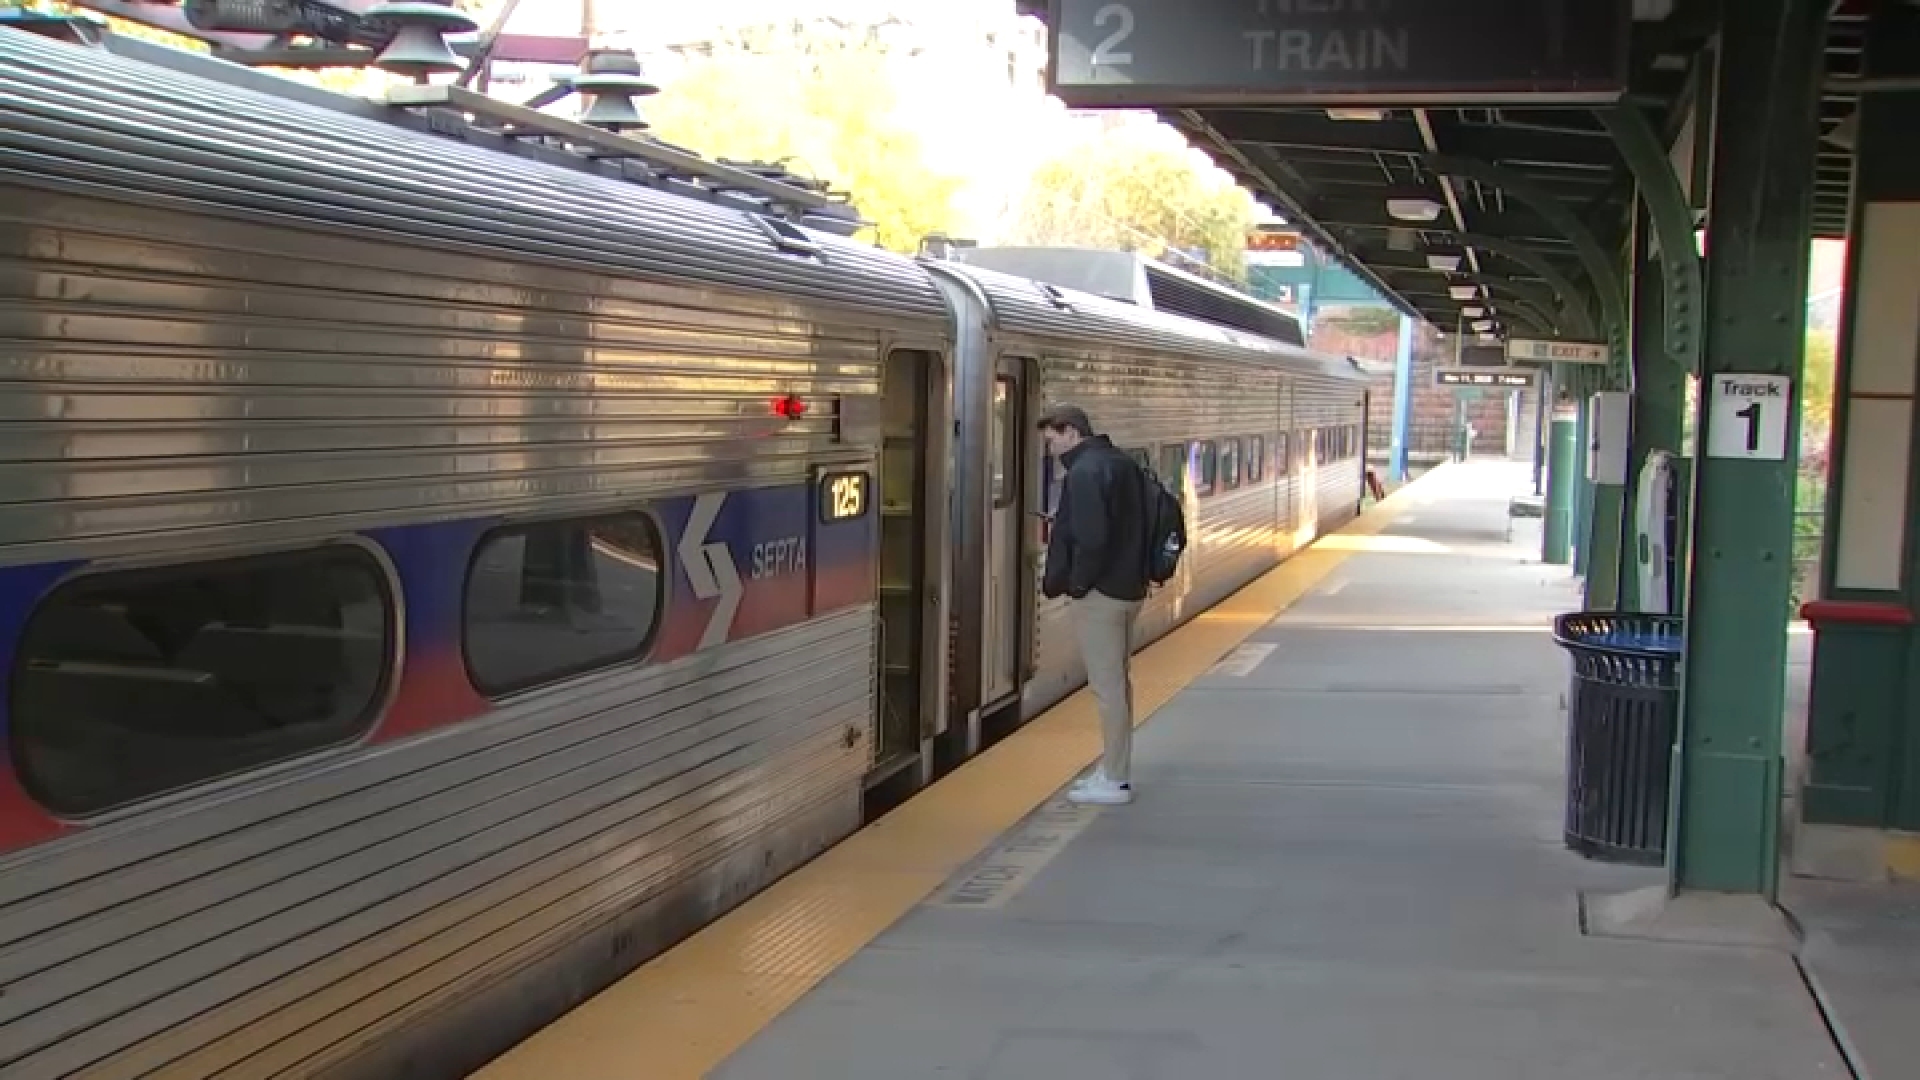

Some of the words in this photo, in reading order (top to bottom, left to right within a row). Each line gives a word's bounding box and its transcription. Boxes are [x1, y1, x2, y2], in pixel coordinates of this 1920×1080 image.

[1091, 4, 1133, 64] 2
[1242, 28, 1409, 71] TRAIN
[1720, 379, 1781, 397] Track
[1735, 402, 1761, 451] 1
[831, 475, 862, 519] 125
[751, 536, 806, 580] SEPTA
